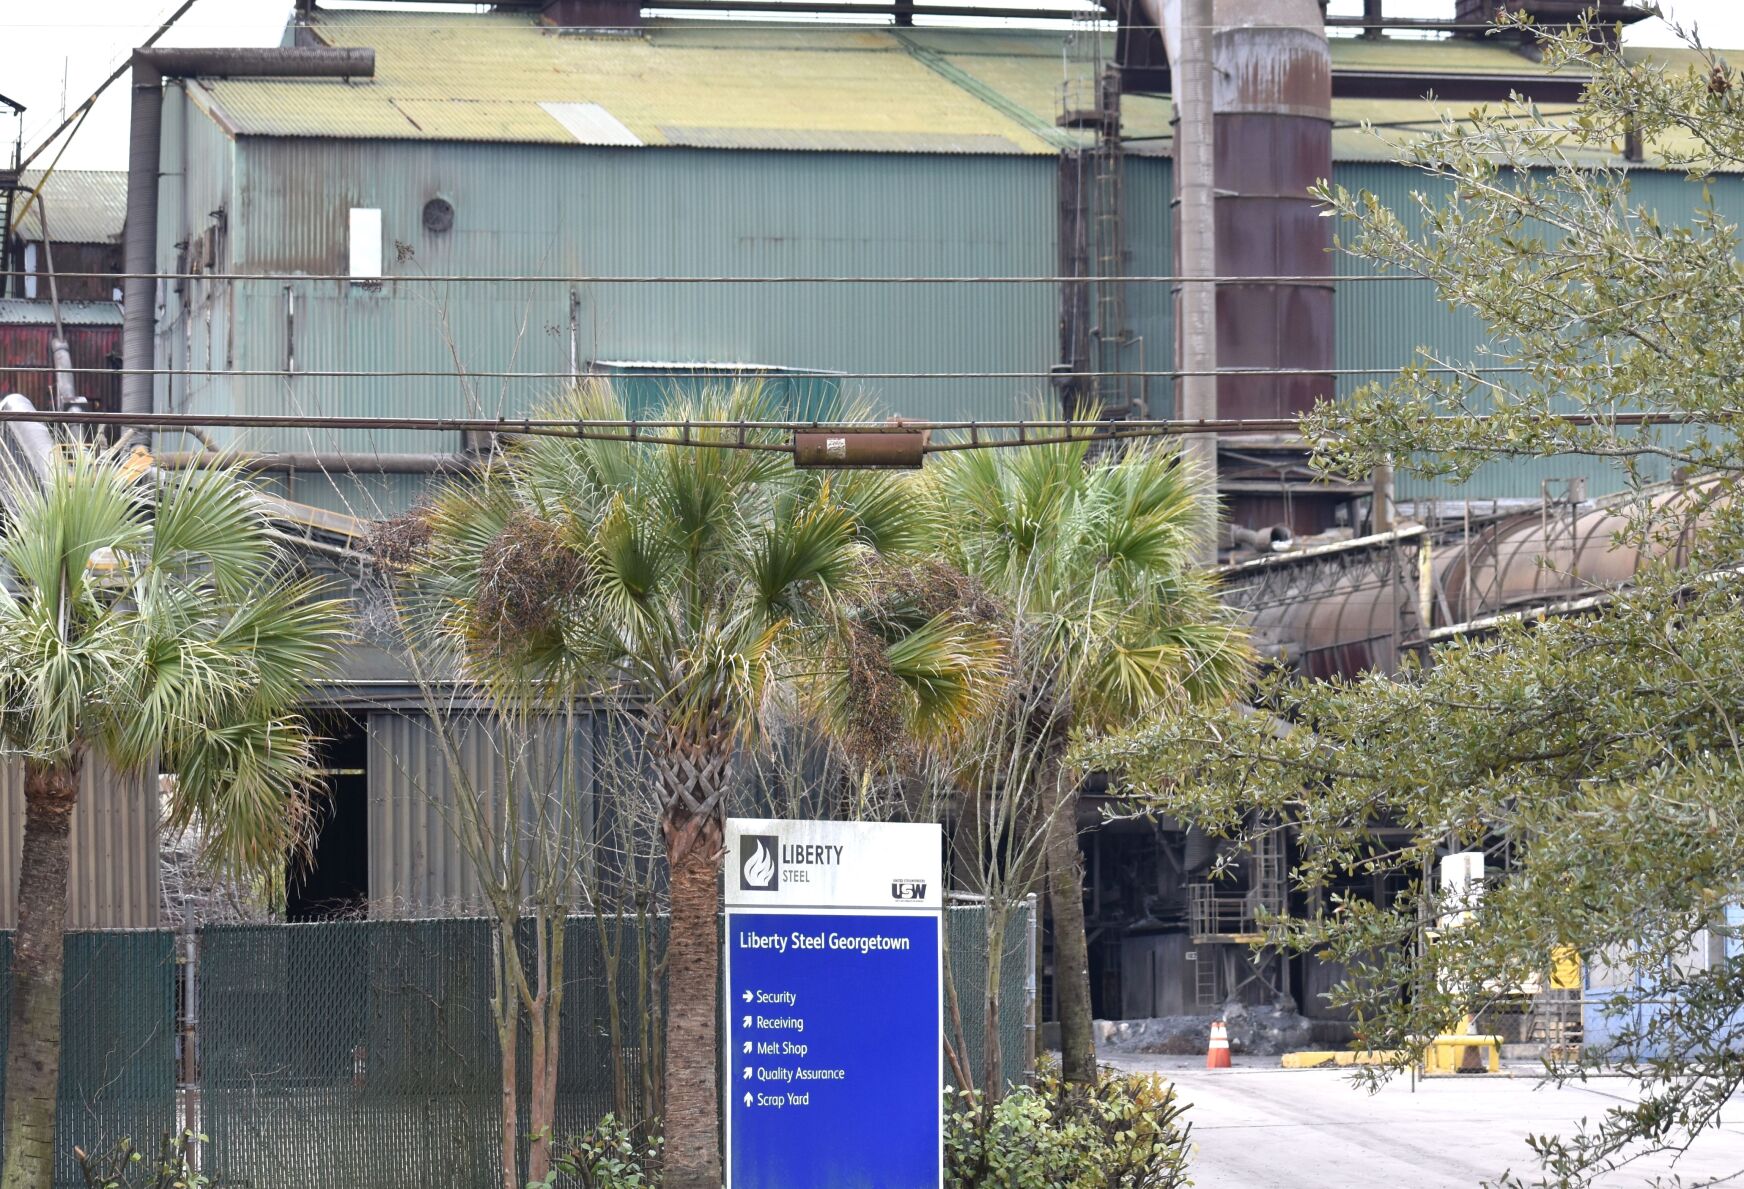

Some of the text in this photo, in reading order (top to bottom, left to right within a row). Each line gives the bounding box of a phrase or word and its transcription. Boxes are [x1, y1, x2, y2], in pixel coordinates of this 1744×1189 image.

[782, 843, 843, 865] LIBERTY
[782, 870, 810, 883] STEEL
[891, 883, 927, 899] USW
[740, 931, 910, 954] Liberty Steel Georgetown
[756, 990, 796, 1006] Security
[757, 1016, 804, 1032] Receiving
[757, 1041, 808, 1057] Melt Shop
[757, 1067, 845, 1083] Quality Assurance
[757, 1092, 809, 1108] Scrap Yard
